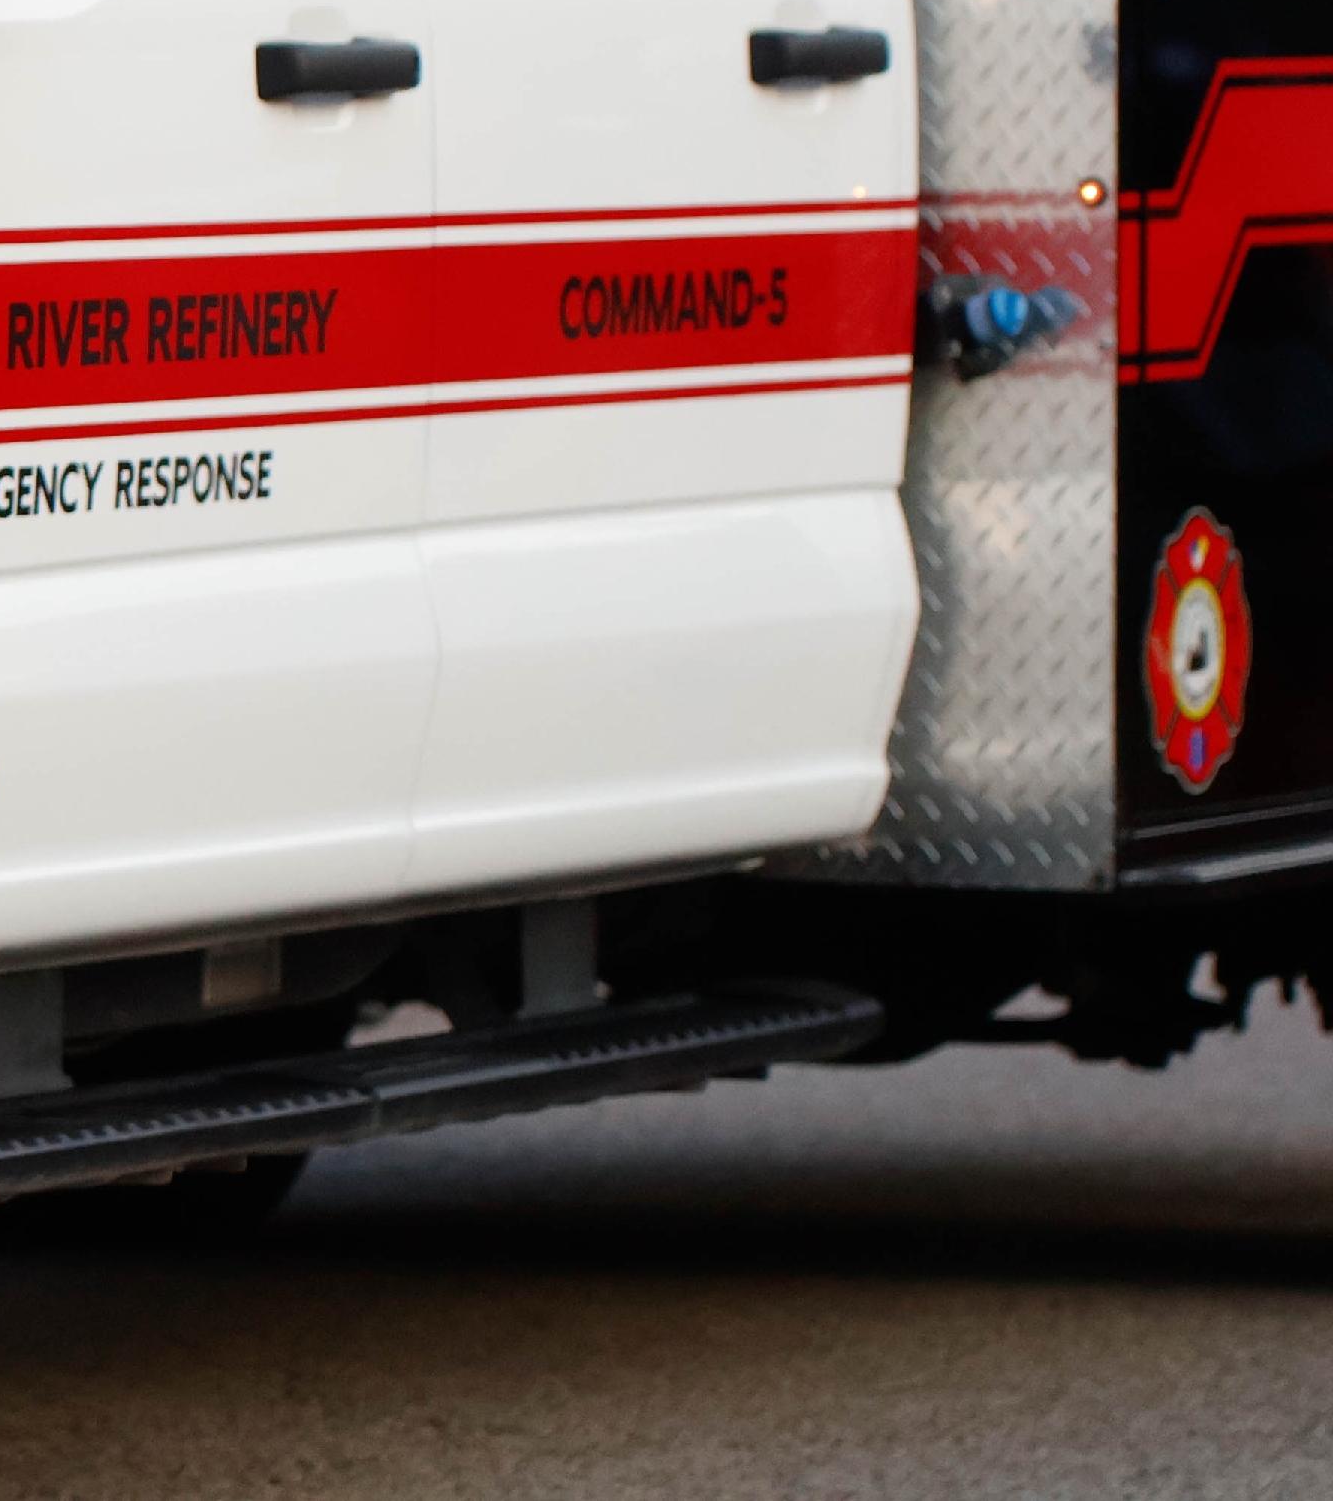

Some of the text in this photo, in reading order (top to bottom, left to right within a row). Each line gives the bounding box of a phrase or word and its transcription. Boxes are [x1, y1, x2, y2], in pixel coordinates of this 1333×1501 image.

[6, 299, 130, 370] RIVER
[146, 289, 338, 363] REFINERY
[560, 267, 789, 339] COMMAND-5
[113, 450, 274, 510] RESPONSE
